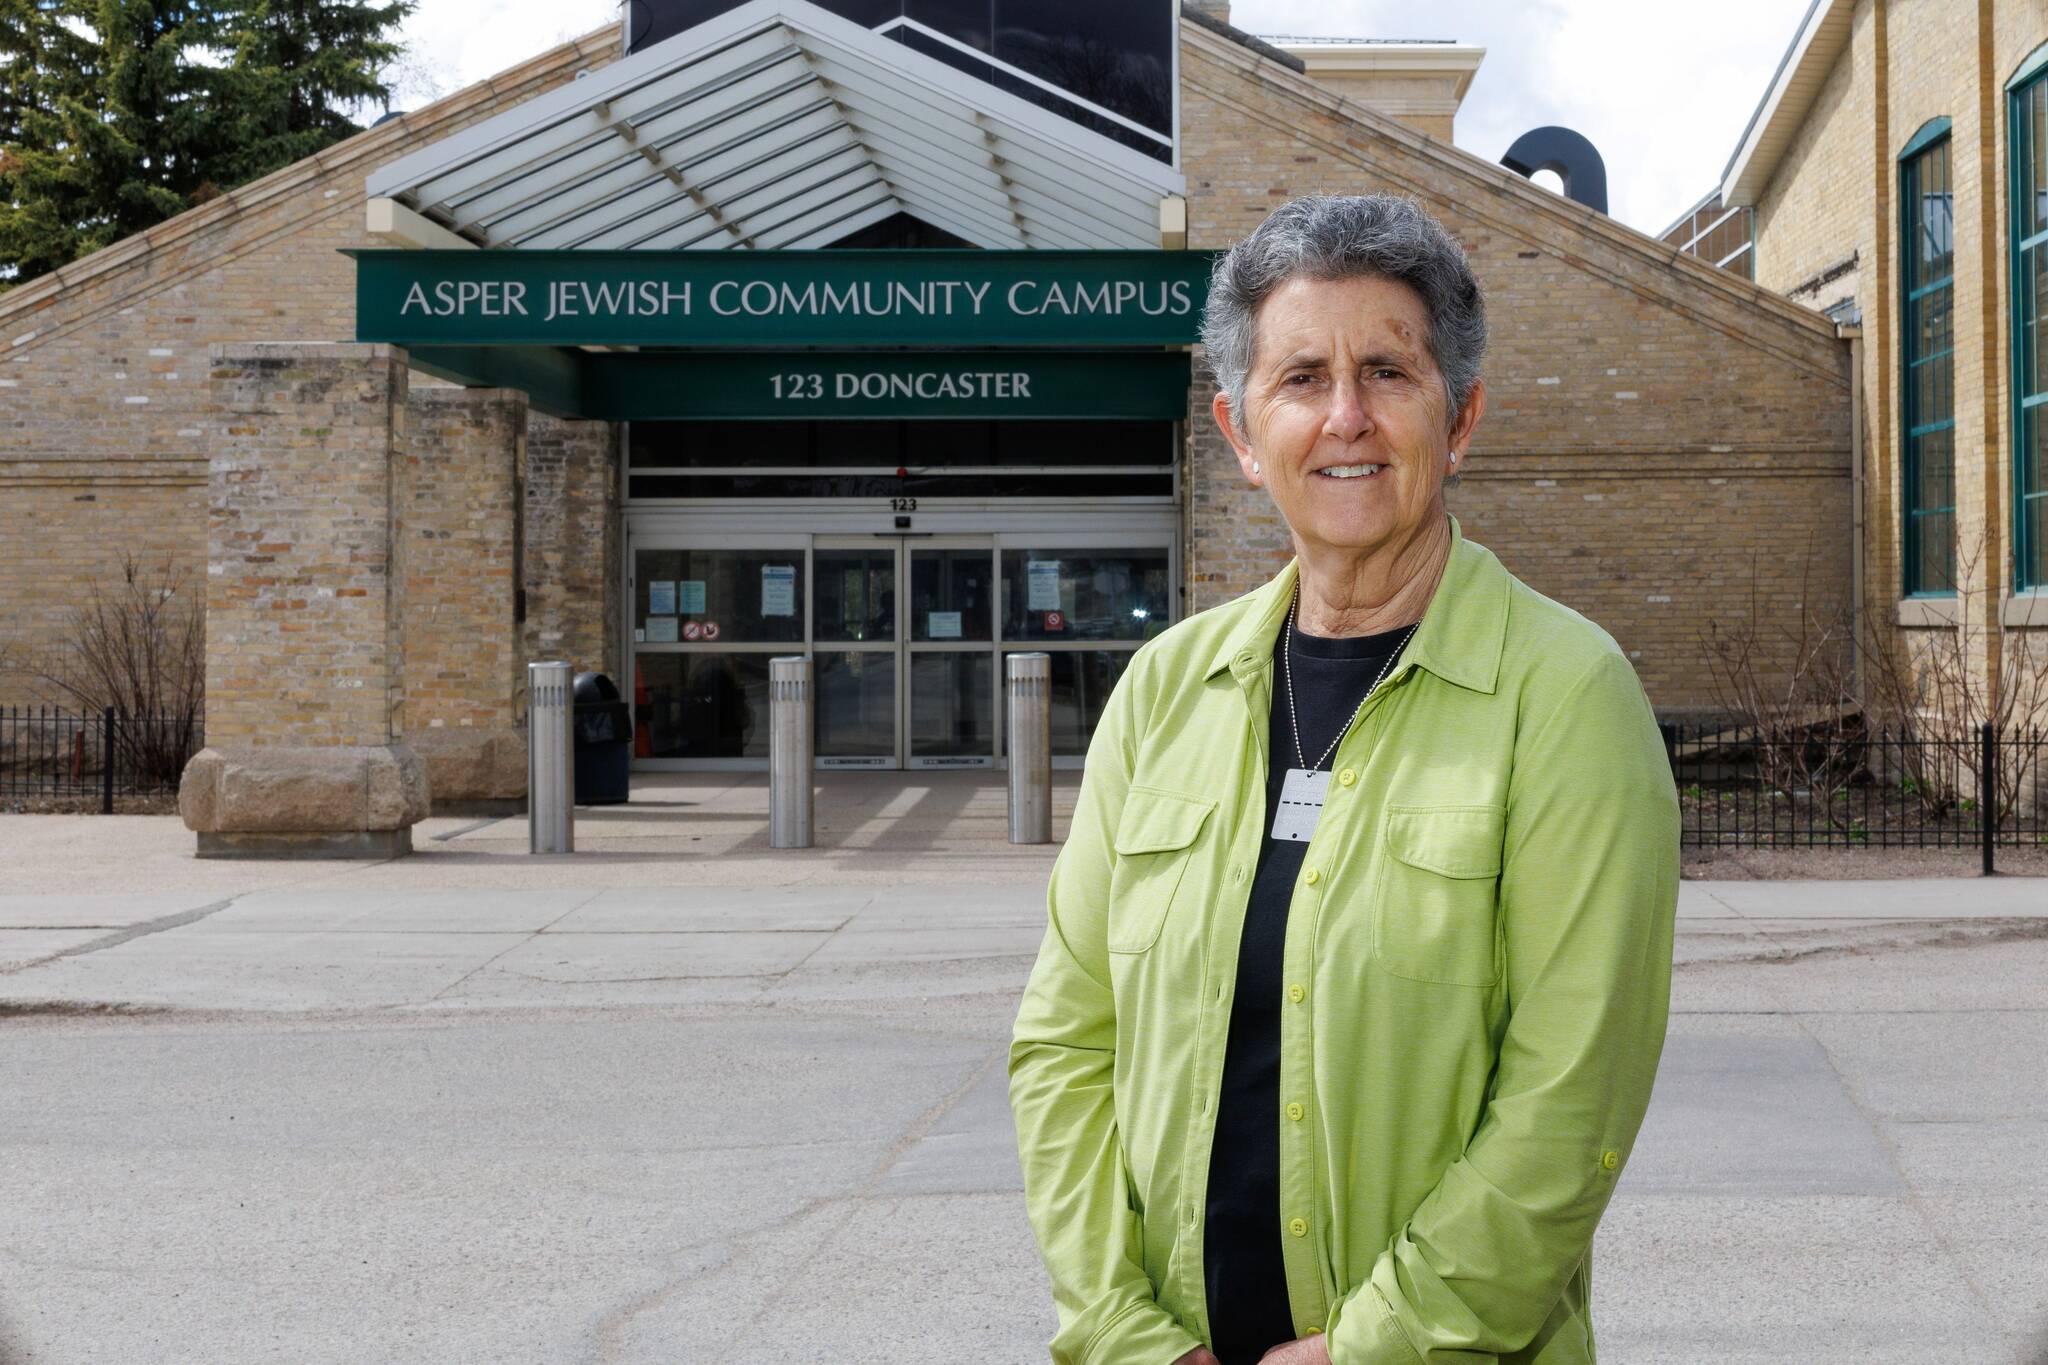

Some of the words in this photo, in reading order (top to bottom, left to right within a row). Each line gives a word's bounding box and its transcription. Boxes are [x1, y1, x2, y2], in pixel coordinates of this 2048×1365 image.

[400, 280, 529, 316] ASPER
[544, 281, 691, 321] JEWISH
[709, 281, 992, 316] COMMUNITY
[1007, 280, 1192, 315] CAMPUS
[769, 373, 824, 399] 123
[835, 372, 1031, 399] DONCASTER
[890, 498, 917, 511] 123
